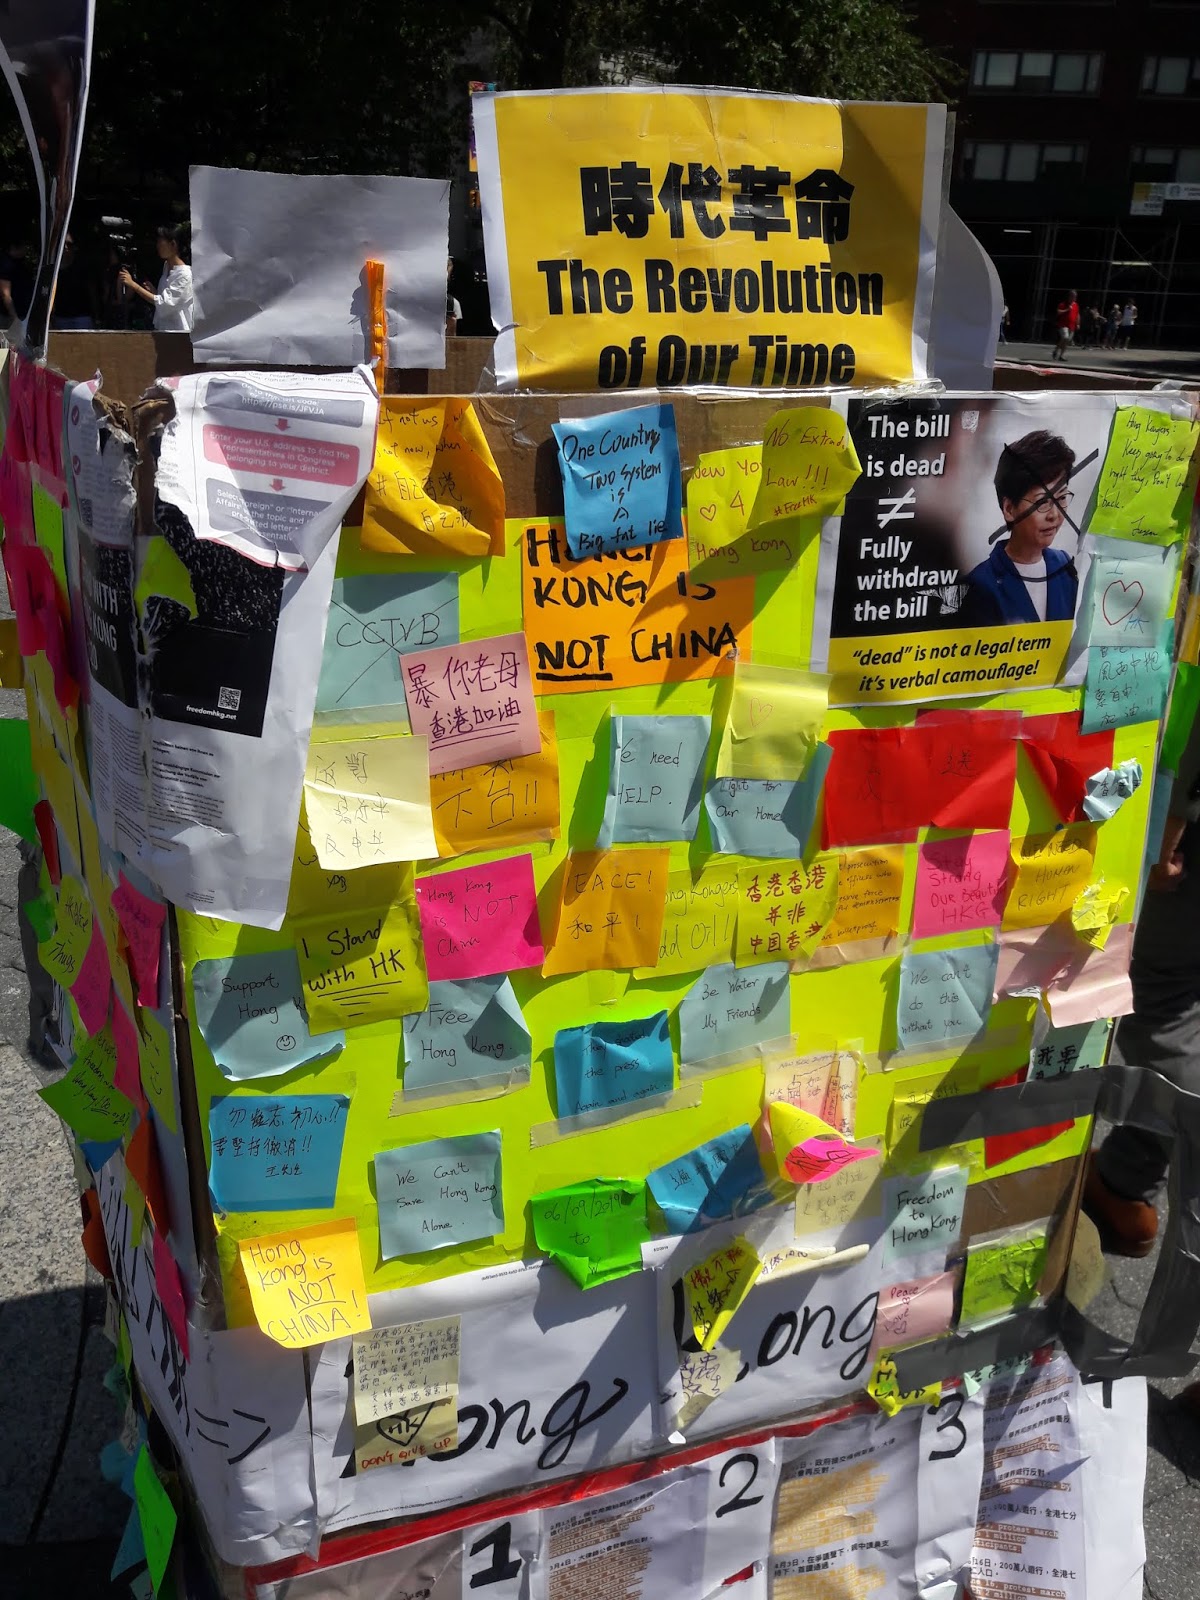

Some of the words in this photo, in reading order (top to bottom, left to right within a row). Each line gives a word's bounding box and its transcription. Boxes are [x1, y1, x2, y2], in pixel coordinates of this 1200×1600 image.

[580, 161, 855, 245] 時代革命
[538, 259, 634, 315] The
[645, 261, 883, 315] Revolution
[598, 335, 646, 389] of
[656, 335, 739, 387] Our
[749, 335, 856, 386] Time
[400, 408, 419, 425] not
[868, 415, 910, 439] The
[915, 414, 950, 438] bill
[562, 435, 595, 463] One
[599, 424, 661, 456] Country
[766, 419, 790, 447] No
[210, 432, 232, 441] Enter
[233, 435, 252, 445] your
[254, 438, 270, 446] U.S.
[273, 441, 305, 453] address
[319, 448, 335, 457] find
[337, 451, 350, 460] the
[222, 444, 285, 459] representatives
[288, 452, 295, 460] in
[298, 453, 335, 468] Congress
[383, 442, 398, 457] not
[436, 438, 460, 453] when
[226, 454, 266, 468] belonging
[268, 458, 276, 466] to
[279, 462, 297, 472] your
[300, 463, 330, 475] district.
[867, 454, 884, 478] is
[890, 453, 945, 477] dead
[583, 473, 616, 491] Two
[610, 483, 625, 504] is
[612, 506, 629, 522] A
[729, 490, 745, 516] 4
[773, 493, 817, 517] #FreeHK
[267, 512, 286, 523] topic
[578, 531, 605, 551] Big
[610, 526, 637, 543] fat
[649, 519, 667, 537] lie
[696, 541, 740, 564] Hong
[859, 536, 913, 563] Fully
[857, 566, 960, 592] withdraw
[1106, 558, 1128, 575] I
[532, 569, 648, 608] KONG
[853, 601, 892, 623] the
[896, 596, 929, 620] bill
[534, 634, 610, 672] NOT
[631, 622, 738, 663] CHINA
[914, 641, 927, 661] is
[930, 641, 958, 660] not
[960, 643, 971, 657] a
[974, 635, 1015, 663] legal
[1017, 636, 1052, 654] term
[407, 651, 521, 709] 暴你老母
[889, 667, 941, 689] verbal
[942, 659, 1039, 689] camouflage!
[185, 704, 237, 721] freedomhkg.net
[430, 696, 521, 739] 香港加油
[650, 741, 682, 767] need
[715, 805, 739, 818] Our
[755, 806, 784, 821] Home
[427, 888, 455, 903] Hong
[464, 879, 493, 893] Kong
[746, 864, 827, 903] 香港香港
[929, 870, 982, 889] Strong
[1017, 883, 1071, 911] RIGHT
[435, 916, 447, 927] is
[463, 894, 519, 923] NOT
[765, 901, 806, 926] 并非
[941, 905, 990, 925] HKG
[301, 938, 310, 959] I
[327, 919, 383, 956] Stand
[437, 938, 480, 957] China
[369, 949, 406, 979] HK
[909, 971, 929, 985] We
[941, 963, 971, 982] can't
[221, 972, 280, 998] Support
[702, 984, 719, 1000] Be
[728, 978, 759, 994] Water
[237, 1003, 279, 1025] Hong
[909, 998, 923, 1011] do
[939, 992, 960, 1005] this
[427, 1002, 474, 1027] Free
[702, 1014, 718, 1033] My
[727, 1003, 762, 1021] Friends
[901, 1021, 933, 1034] without
[943, 1019, 962, 1037] you
[421, 1039, 457, 1066] Hong
[585, 1065, 603, 1078] the
[614, 1059, 640, 1079] press
[607, 1093, 627, 1105] and
[396, 1173, 419, 1186] We
[433, 1162, 470, 1179] Can't
[396, 1197, 424, 1208] Save
[439, 1187, 468, 1202] Hong
[474, 1182, 497, 1201] Kong
[896, 1184, 954, 1210] Freedom
[909, 1211, 925, 1220] to
[569, 1232, 591, 1246] to
[892, 1225, 929, 1247] Hong
[930, 1214, 960, 1233] Kong
[249, 1238, 305, 1269] Hong
[312, 1252, 333, 1270] is
[287, 1273, 337, 1309] NOT
[890, 1285, 920, 1299] Peace
[926, 1391, 967, 1462] 3
[433, 1436, 452, 1449] UP
[715, 1453, 764, 1519] 2
[994, 1534, 1026, 1542] million
[998, 1524, 1030, 1534] protest
[1034, 1529, 1058, 1538] march
[469, 1521, 522, 1589] 1
[1003, 1583, 1036, 1594] protest
[1040, 1589, 1066, 1598] march
